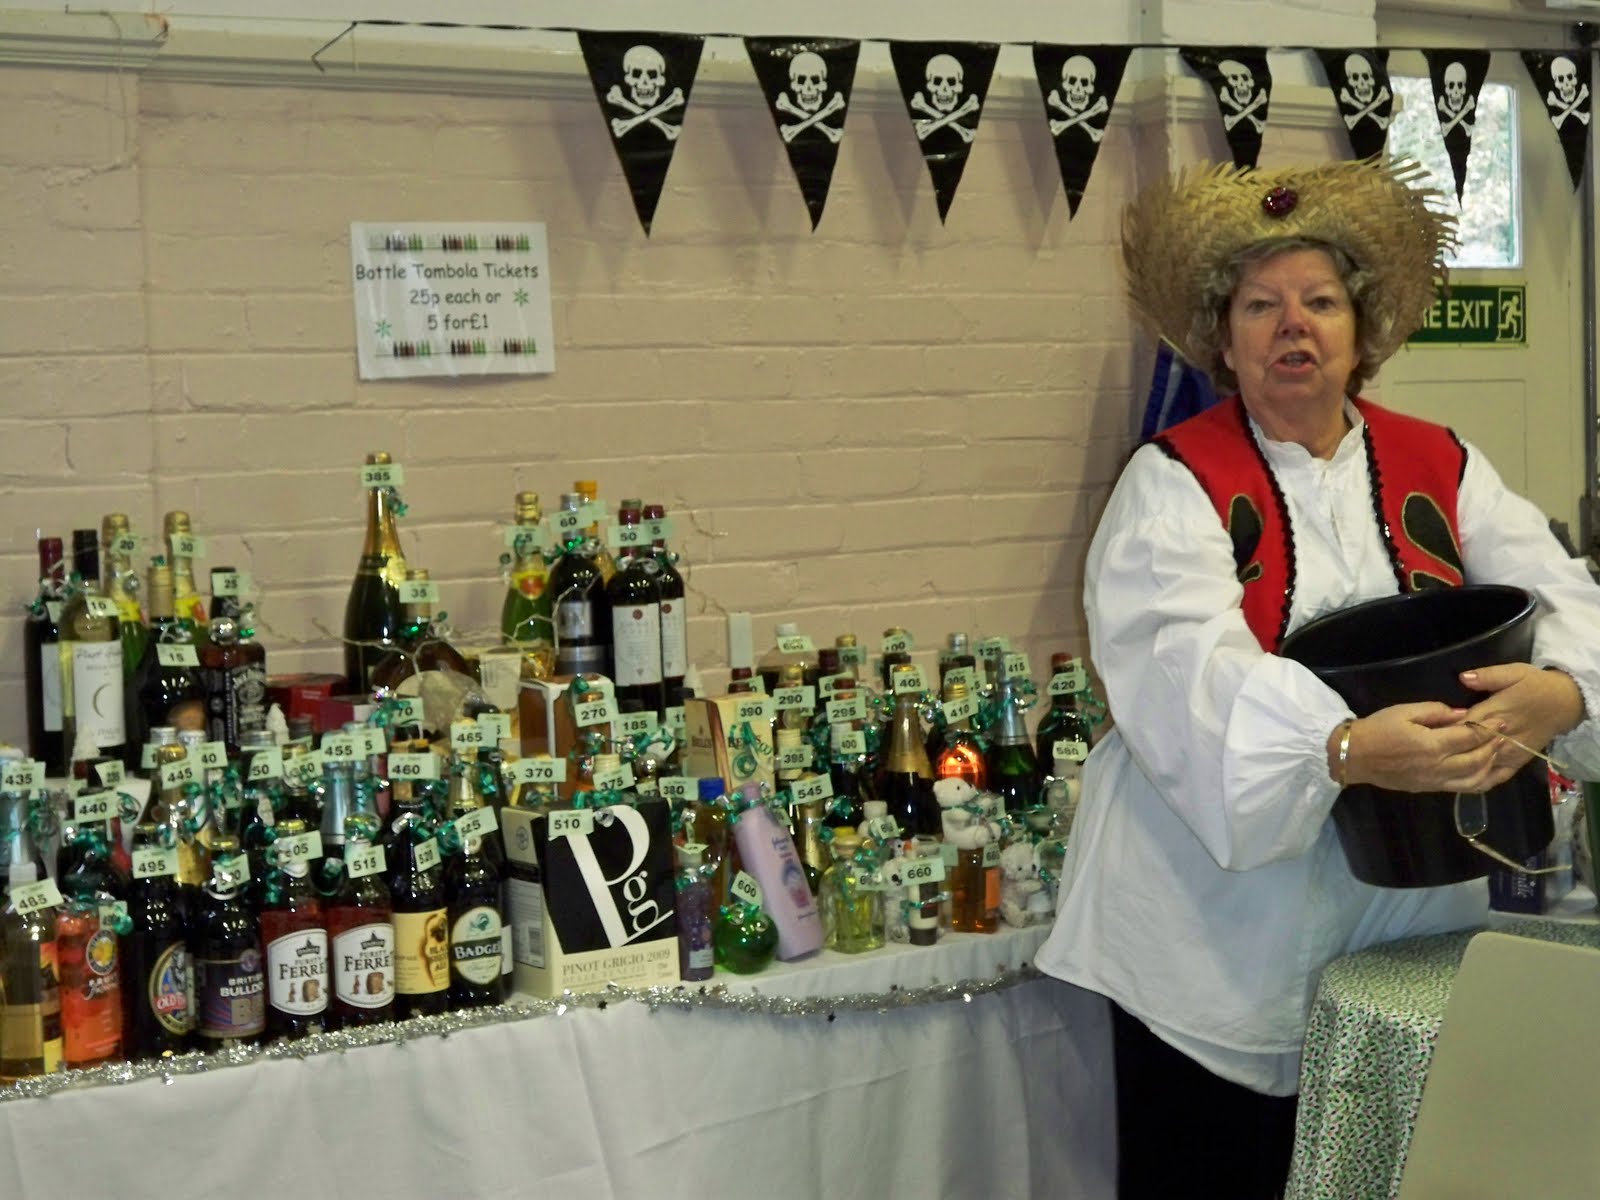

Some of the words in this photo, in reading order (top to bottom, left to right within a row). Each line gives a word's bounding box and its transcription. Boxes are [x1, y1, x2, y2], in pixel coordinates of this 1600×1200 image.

[355, 264, 407, 280] Bottle
[414, 263, 479, 279] Tombola
[483, 263, 539, 279] Tickets
[410, 289, 440, 305] 25p
[445, 288, 482, 304] each
[485, 294, 502, 304] or
[1447, 299, 1493, 329] EXIT
[427, 316, 438, 331] 5
[560, 516, 578, 528] 60
[620, 531, 637, 542] 50
[411, 588, 427, 598] 35
[1008, 662, 1025, 672] 415
[899, 677, 921, 688] 405
[1052, 681, 1076, 691] 420
[778, 694, 803, 706] 290
[581, 708, 607, 720] 270
[740, 706, 763, 718] 390
[832, 706, 857, 718] 295
[950, 704, 970, 718] 410
[623, 720, 648, 731] 185
[456, 732, 482, 743] 465
[324, 745, 353, 756] 455
[784, 754, 804, 764] 395
[167, 768, 193, 782] 445
[392, 764, 420, 775] 460
[525, 768, 553, 778] 370
[5, 773, 33, 786] 435
[600, 777, 624, 792] 375
[797, 785, 823, 799] 545
[79, 802, 108, 816] 440
[554, 818, 581, 830] 510
[138, 860, 166, 873] 495
[353, 859, 377, 871] 515
[907, 866, 932, 880] 660
[737, 880, 757, 898] 600
[563, 961, 600, 976] PINOT
[603, 953, 644, 969] GRIGIO
